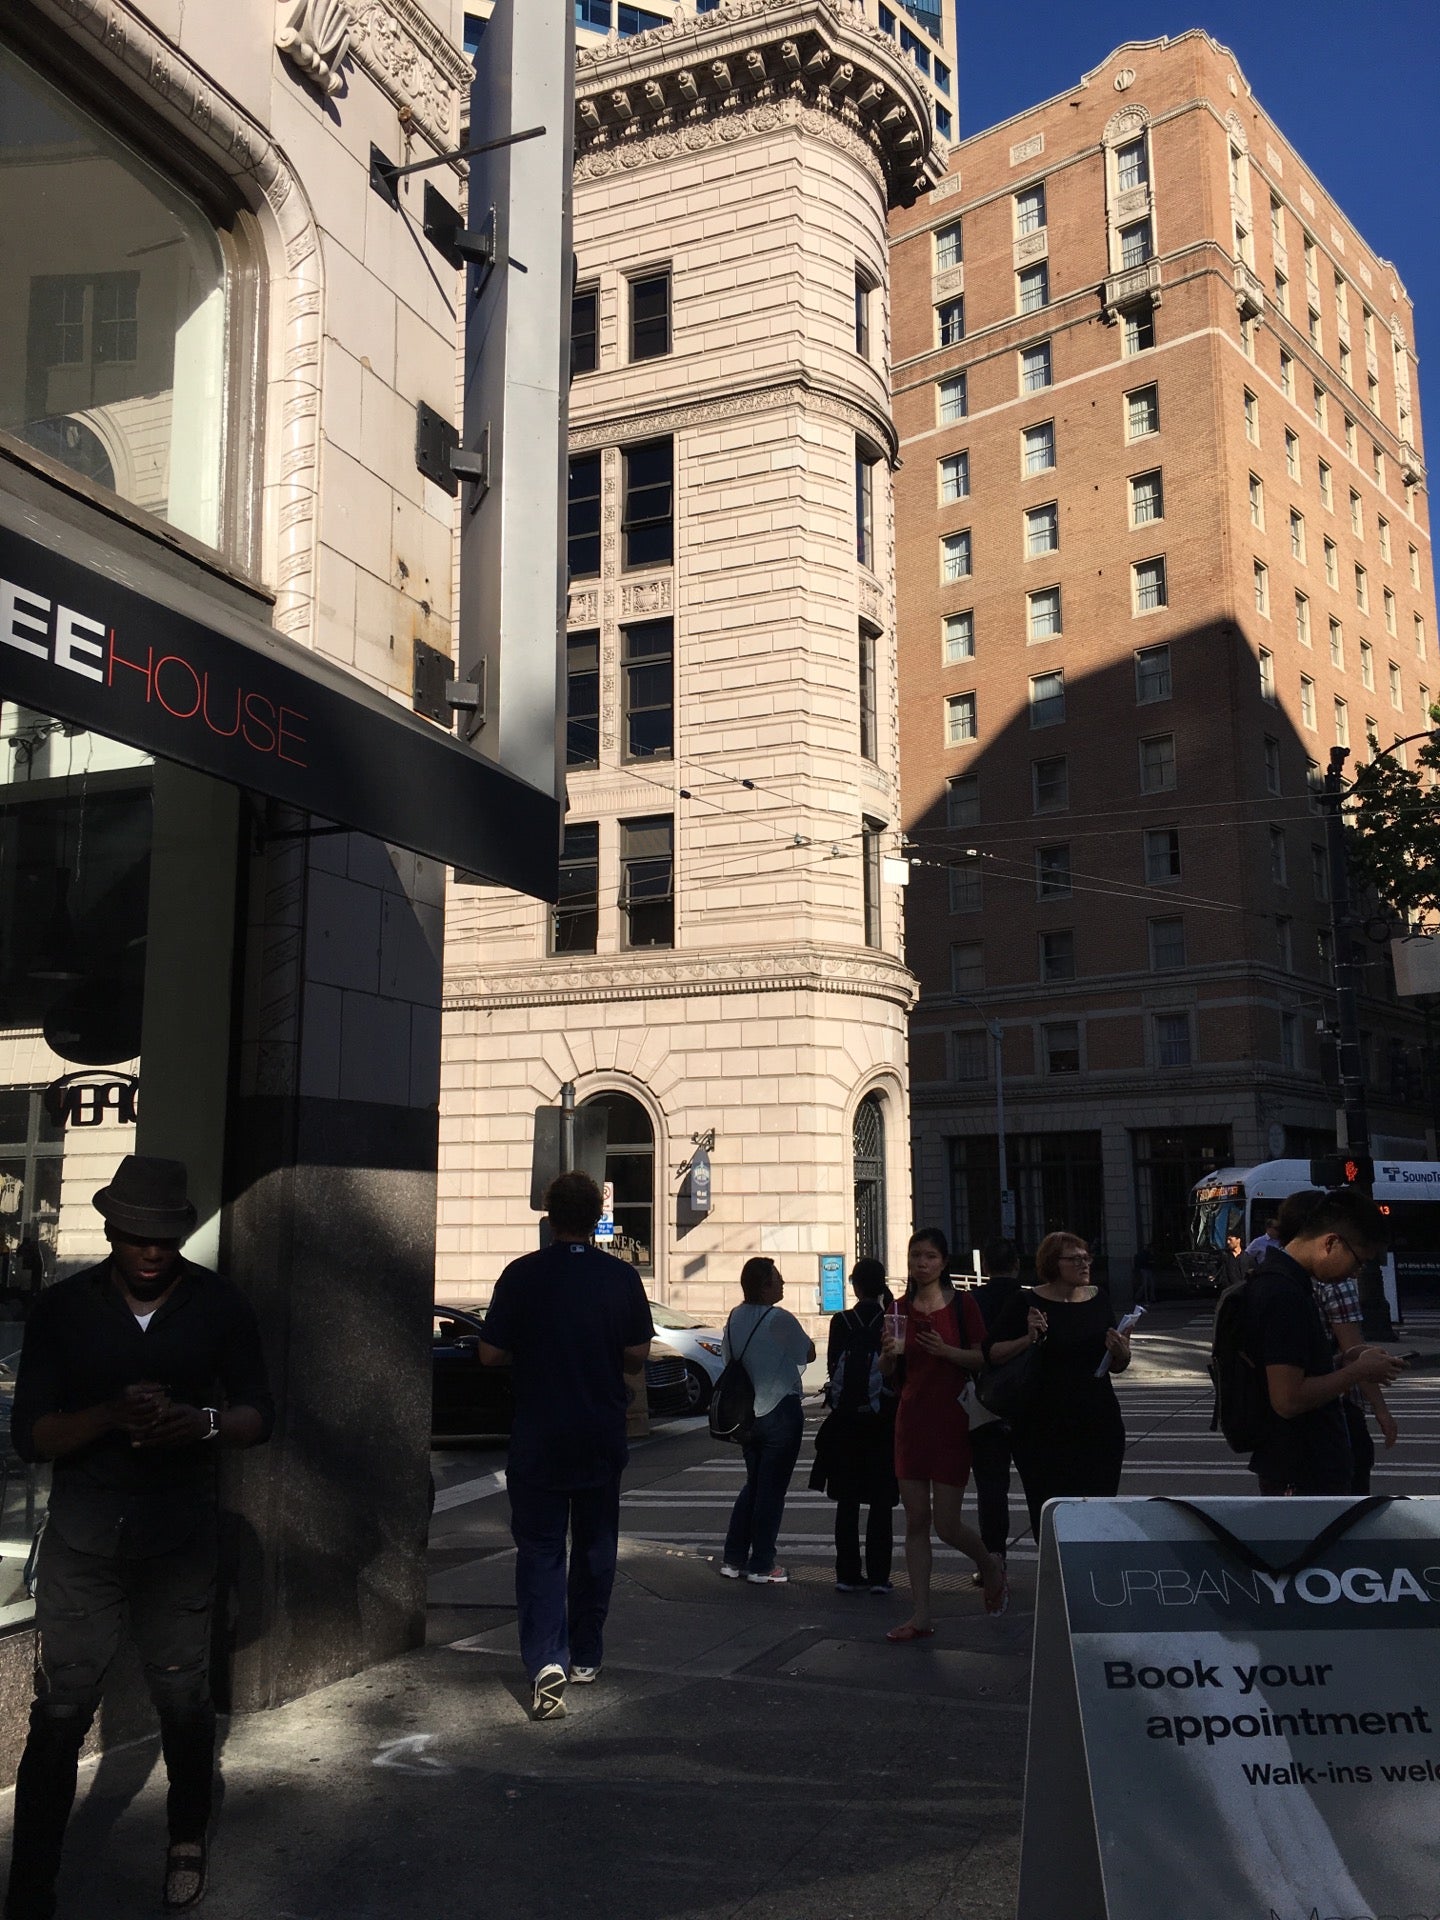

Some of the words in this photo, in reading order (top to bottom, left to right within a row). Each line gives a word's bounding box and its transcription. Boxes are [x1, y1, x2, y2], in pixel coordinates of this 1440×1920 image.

[1103, 1659, 1223, 1690] Book
[1233, 1663, 1333, 1695] your
[1146, 1705, 1432, 1746] appointment
[1241, 1761, 1373, 1786] Walk-ins
